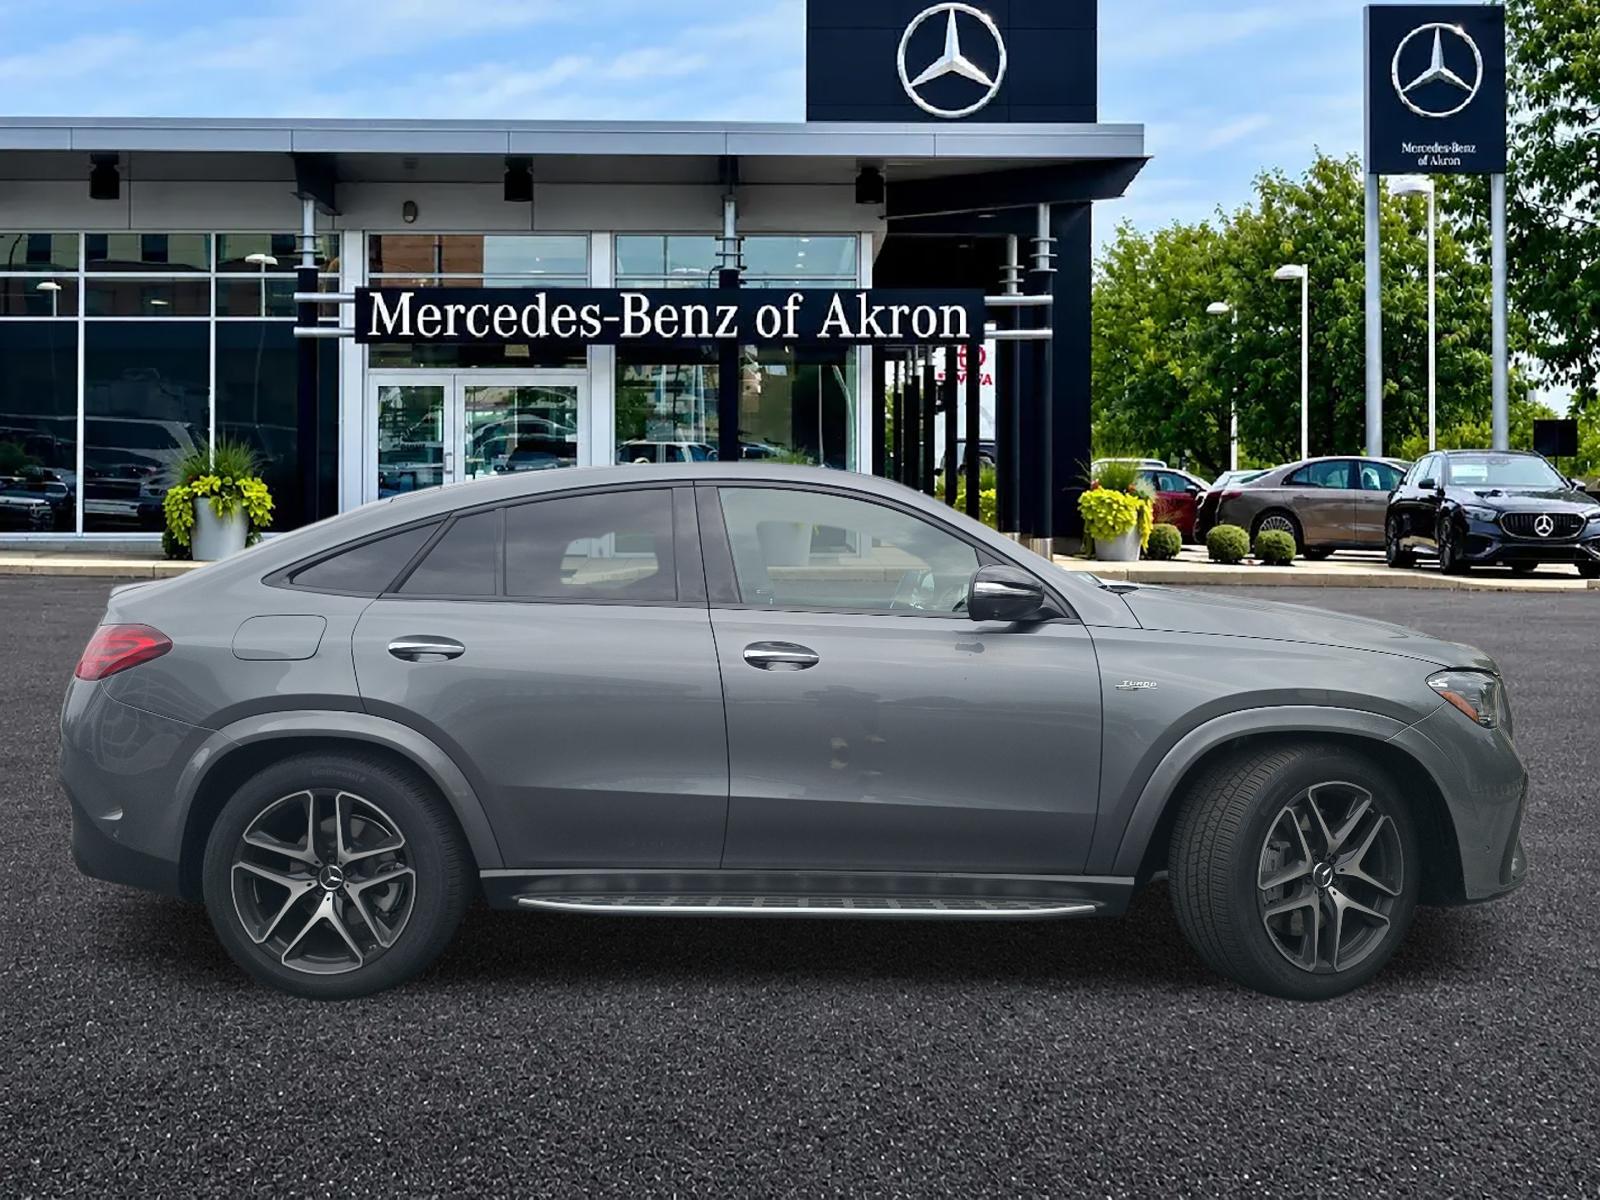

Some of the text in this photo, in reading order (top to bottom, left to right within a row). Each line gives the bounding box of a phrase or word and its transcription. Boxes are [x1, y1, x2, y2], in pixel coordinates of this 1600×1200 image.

[1401, 141, 1477, 154] Mercedes-Benz
[1417, 154, 1461, 166] of Akron
[367, 291, 970, 339] Mercedes-Benz of Akron
